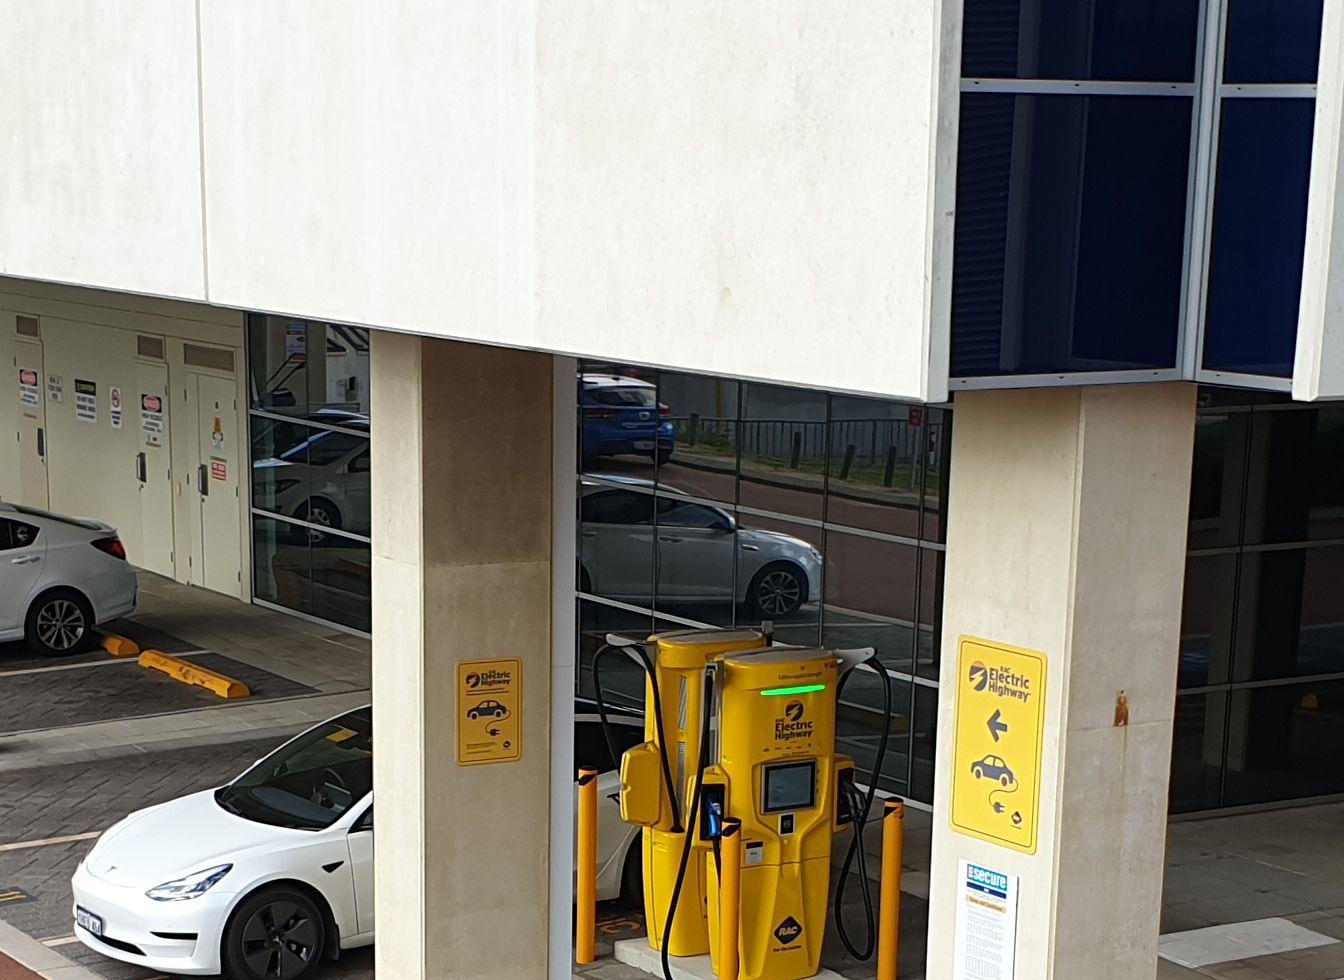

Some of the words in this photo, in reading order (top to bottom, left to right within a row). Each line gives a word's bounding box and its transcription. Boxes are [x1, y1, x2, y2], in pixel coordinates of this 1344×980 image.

[989, 668, 1030, 689] Electric
[988, 681, 1031, 703] Highway
[775, 720, 813, 732] Electric
[774, 729, 813, 741] Highway
[778, 926, 798, 936] RAC
